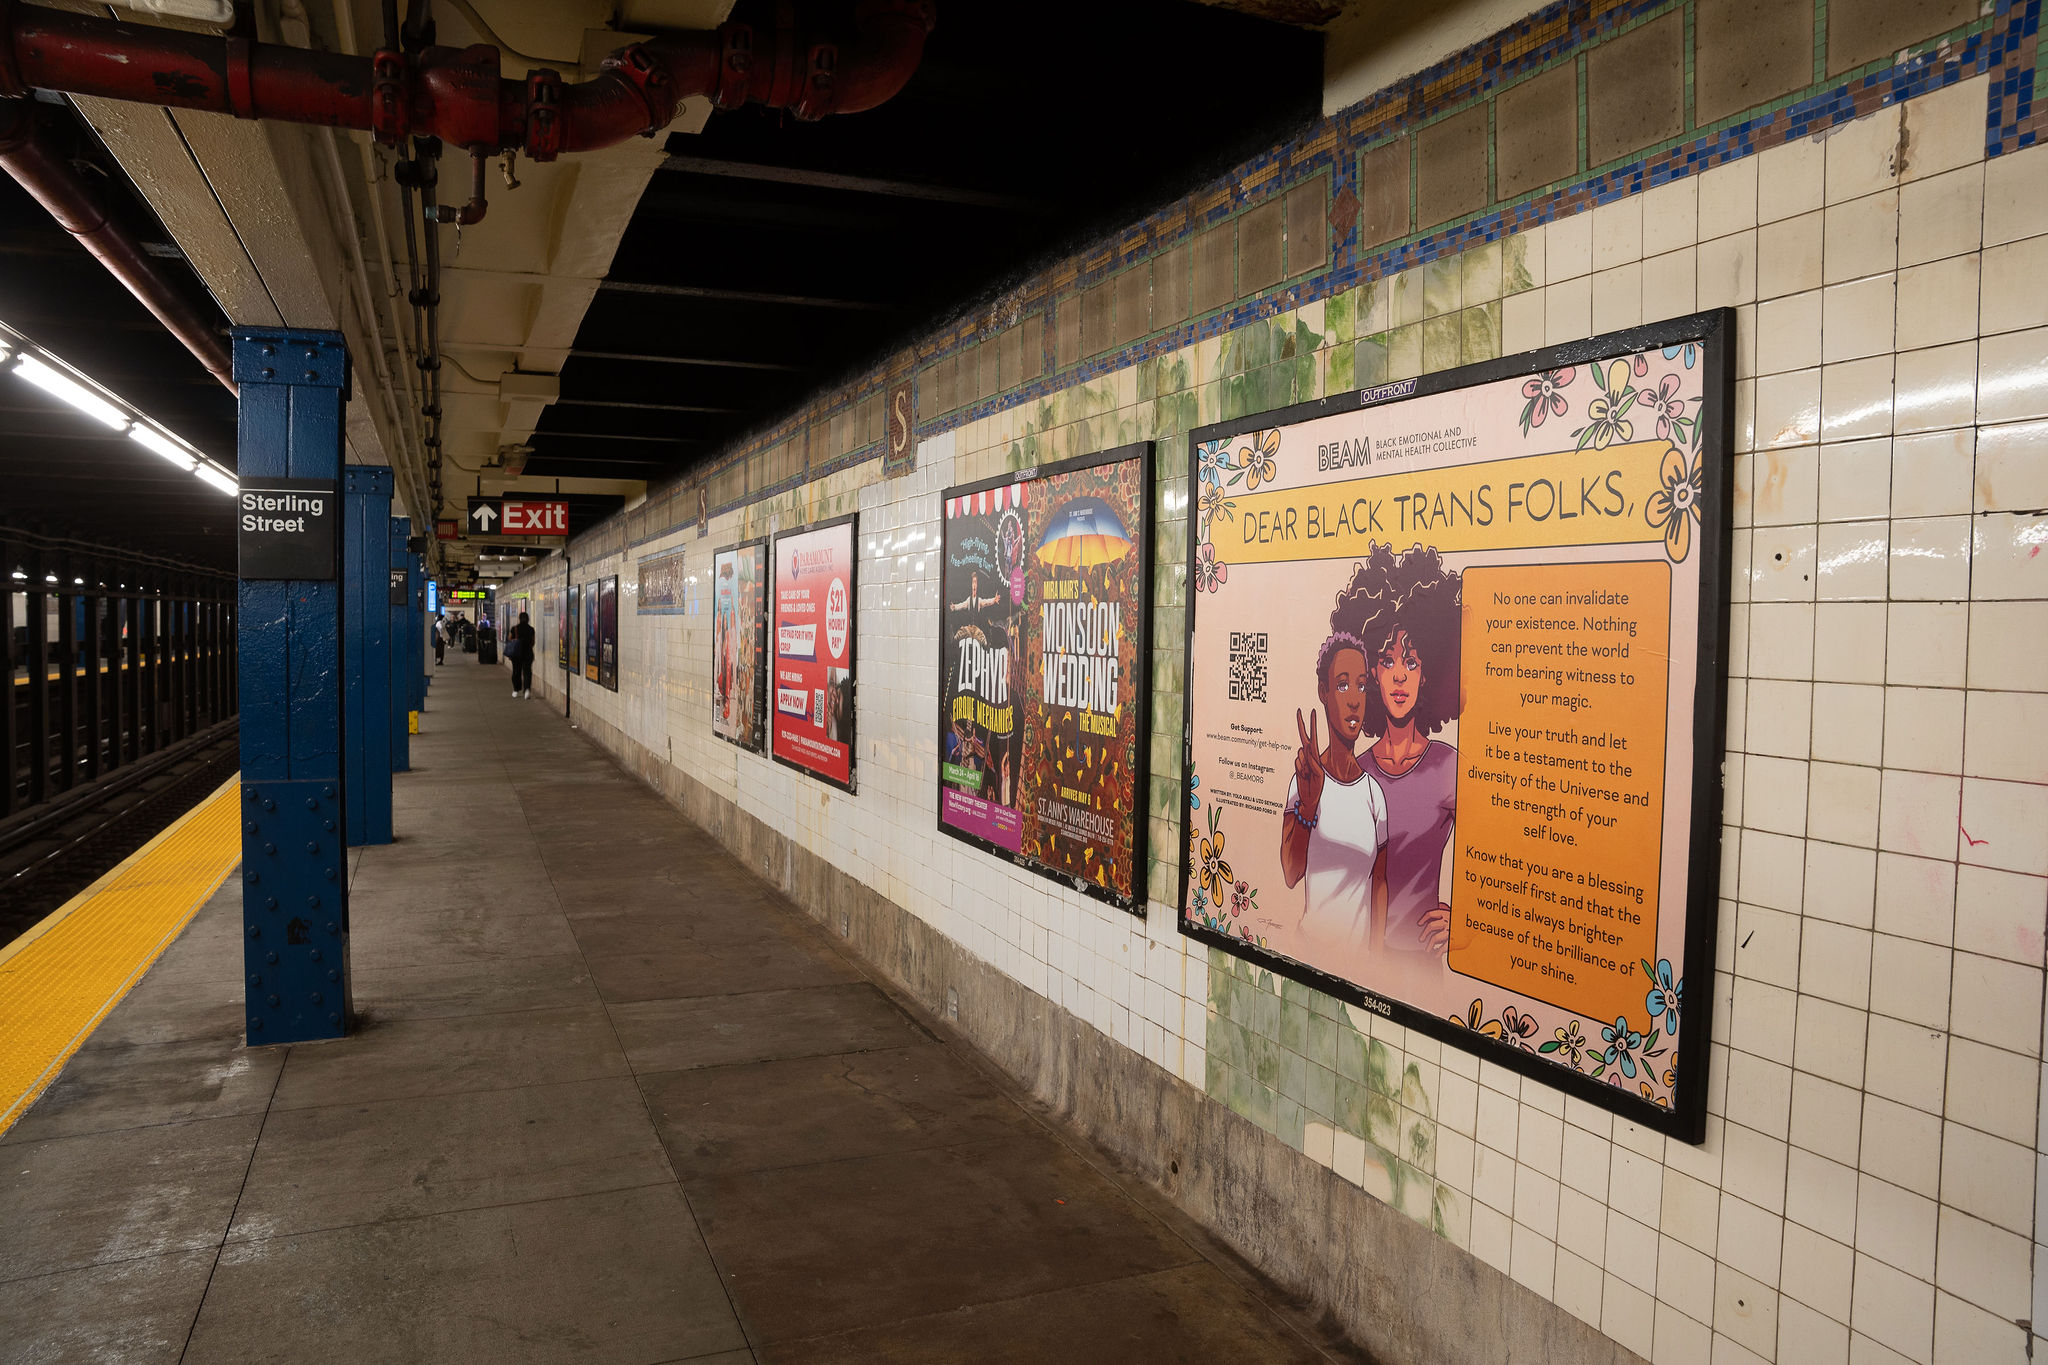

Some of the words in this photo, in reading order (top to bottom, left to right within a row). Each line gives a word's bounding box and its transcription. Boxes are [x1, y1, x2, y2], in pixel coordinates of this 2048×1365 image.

[1363, 381, 1413, 402] OUTFRONT
[893, 389, 907, 457] S
[1376, 437, 1397, 449] BLACK
[1399, 430, 1442, 445] EMOTIONAL
[1444, 426, 1462, 437] AND
[1376, 448, 1403, 461] MENTAL
[1405, 445, 1431, 457] HEALTH
[1433, 436, 1477, 452] COLLECTIVE
[1318, 436, 1372, 472] BEAM
[242, 493, 324, 516] Sterling
[503, 502, 566, 529] Exit
[1243, 507, 1297, 544] DEAR
[1307, 498, 1384, 539] BLACK
[1393, 484, 1494, 532] TRANS
[1508, 470, 1634, 523] FOLKS,
[242, 514, 305, 532] Street
[830, 587, 843, 615] $21
[1043, 580, 1058, 600] MIRA
[1059, 579, 1079, 600] NAIR'S
[1493, 591, 1511, 605] No
[1514, 594, 1537, 605] one
[1539, 594, 1563, 605] can
[1566, 589, 1629, 605] invalidate
[828, 618, 845, 631] HOURLY
[1042, 602, 1120, 657] MONSOON
[1486, 618, 1513, 634] your
[1516, 616, 1579, 631] existence.
[1583, 616, 1637, 637] Nothing
[1491, 642, 1512, 653] can
[1515, 643, 1563, 658] prevent
[1566, 641, 1588, 657] the
[1591, 643, 1630, 658] world
[958, 637, 1008, 704] ZEPHYR
[1485, 662, 1513, 677] from
[1516, 664, 1563, 686] bearing
[1566, 667, 1616, 684] witness
[1620, 672, 1635, 685] to
[1042, 653, 1119, 714] WEDDING
[780, 692, 793, 707] APPLY
[1520, 692, 1548, 708] your
[1551, 693, 1592, 712] magic.
[952, 695, 975, 722] CIRQUE
[977, 700, 1014, 734] MECHANICS
[1079, 712, 1090, 732] THE
[1090, 714, 1117, 738] MUSICAL
[1206, 732, 1292, 751] www.beam.community/get-help-now
[1240, 724, 1264, 734] Support:
[1488, 720, 1512, 736] Live
[1515, 727, 1543, 742] your
[1546, 729, 1578, 744] truth
[1581, 732, 1606, 748] and
[1609, 733, 1628, 750] let
[1218, 756, 1233, 766] Follow
[1248, 762, 1276, 774] Instagram:
[1485, 745, 1493, 758] it
[1496, 745, 1510, 760] be
[1513, 751, 1521, 762] a
[1523, 751, 1589, 771] testament
[1592, 759, 1606, 774] to
[1609, 760, 1633, 777] the
[1229, 770, 1264, 784] @_BEAMORG
[1468, 765, 1517, 790] diversity
[1520, 774, 1534, 788] of
[1535, 775, 1556, 792] the
[1560, 779, 1620, 802] Universe
[1623, 791, 1650, 807] and
[1210, 788, 1226, 796] WRITTEN
[1232, 792, 1242, 800] YOLO
[1215, 797, 1239, 807] ILLUSTRATED
[1245, 803, 1262, 812] RICHARD
[1038, 797, 1047, 815] ST.
[1047, 800, 1068, 823] ANN'S
[1068, 806, 1114, 838] WAREHOUSE
[1491, 793, 1511, 809] the
[1513, 800, 1566, 821] strength
[1569, 807, 1584, 822] of
[1586, 812, 1618, 828] your
[1523, 824, 1547, 839] self
[1549, 826, 1578, 846] love.
[1465, 844, 1497, 863] Know
[1499, 852, 1524, 871] that
[1526, 862, 1549, 877] you
[1551, 868, 1574, 882] are
[1577, 874, 1585, 885] a
[1588, 871, 1645, 905] blessing
[1465, 870, 1477, 883] to
[1480, 874, 1529, 896] yourself
[1530, 883, 1557, 903] first
[1560, 895, 1584, 910] and
[1587, 899, 1615, 919] that
[1617, 906, 1642, 925] the
[1476, 897, 1509, 914] world
[1511, 903, 1521, 918] is
[1524, 907, 1565, 933] always
[1568, 918, 1624, 946] brighter
[1465, 913, 1514, 941] because
[1517, 931, 1531, 945] of
[1532, 934, 1553, 951] the
[1556, 940, 1617, 971] brilliance
[1620, 961, 1636, 977] of
[1510, 955, 1538, 971] your
[1541, 963, 1578, 985] shine.
[1363, 995, 1391, 1016] 354-023
